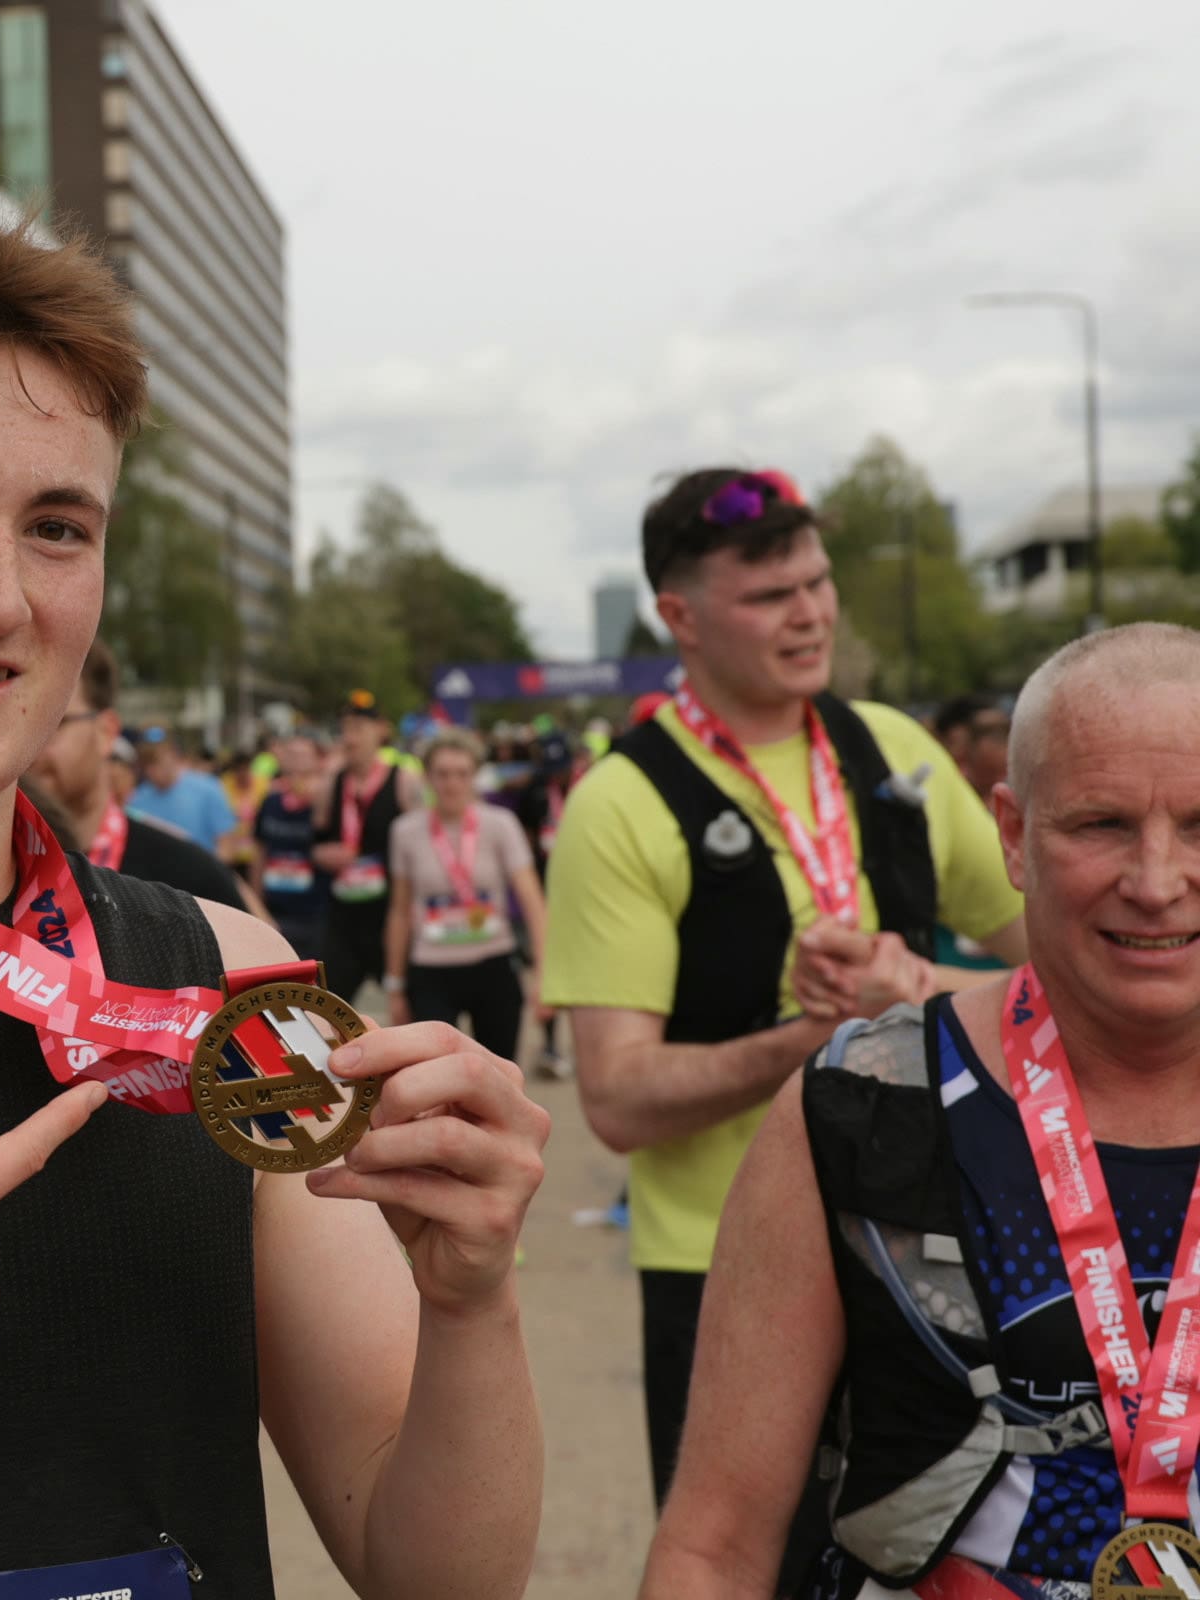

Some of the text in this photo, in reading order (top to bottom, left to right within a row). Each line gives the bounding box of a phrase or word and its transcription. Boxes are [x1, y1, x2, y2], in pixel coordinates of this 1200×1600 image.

[90, 1012, 185, 1036] MANCHESTER
[98, 1000, 195, 1023] MARATHON
[205, 990, 325, 1050] MANCHESTER
[104, 1058, 194, 1100] FINISH
[198, 1061, 227, 1134] ADIDAS
[257, 1154, 310, 1168] APRIL
[1061, 1131, 1093, 1214] MANCHESTER
[1081, 1246, 1139, 1389] FINISHER
[1163, 1307, 1192, 1390] MANCHESTER
